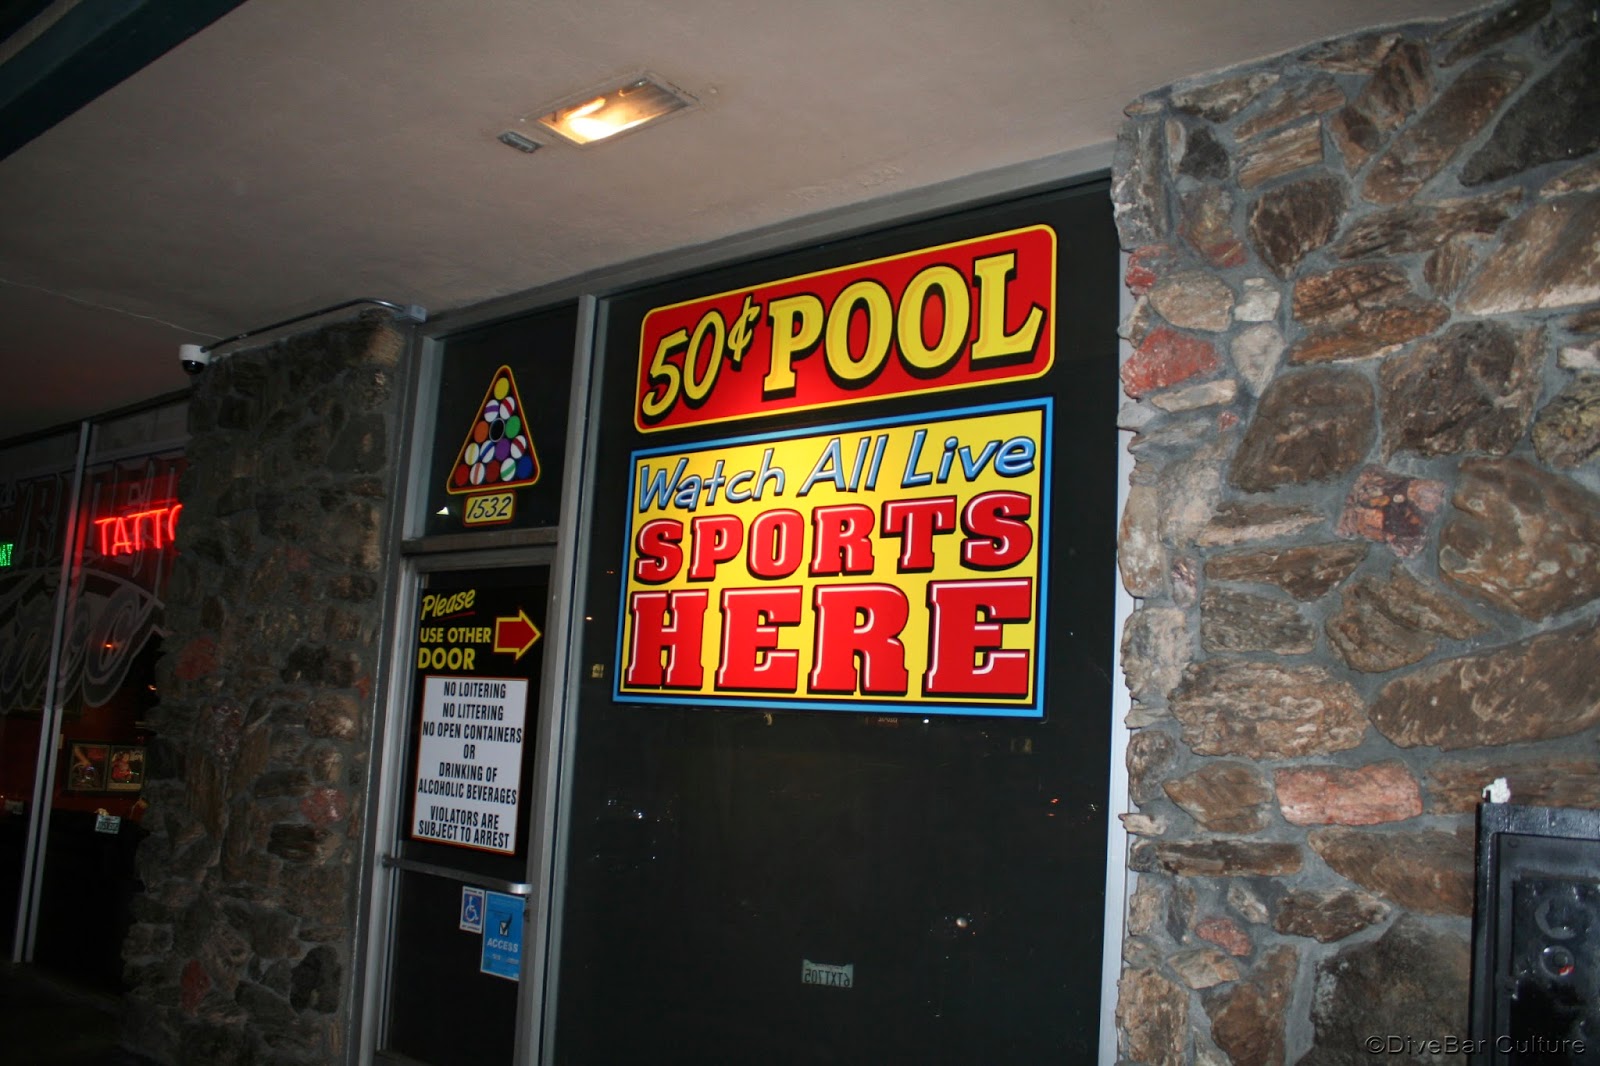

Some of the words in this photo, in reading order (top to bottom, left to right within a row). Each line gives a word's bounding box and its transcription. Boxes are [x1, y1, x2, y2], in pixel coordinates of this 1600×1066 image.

[640, 295, 761, 417] 50¢
[762, 251, 1046, 400] POOL
[637, 448, 786, 513] Watch
[798, 430, 890, 497] All
[900, 429, 1036, 491] Live
[466, 496, 512, 520] 1532
[635, 490, 1033, 585] SPORTS
[420, 589, 476, 620] Please
[420, 627, 443, 643] USE
[447, 627, 492, 644] OTHER
[625, 578, 1032, 699] HERE
[417, 647, 475, 670] DOOR
[443, 681, 456, 696] NO
[458, 682, 506, 699] LOITERING
[442, 703, 455, 718] NO
[457, 703, 504, 721] LITTERING
[422, 721, 435, 736] NO
[437, 722, 461, 738] OPEN
[463, 724, 522, 743] CONTAINERS
[463, 744, 475, 760] OR
[439, 762, 483, 781] DRINKING
[486, 767, 497, 782] OF
[418, 778, 464, 798] ALCOHOLIC
[466, 784, 517, 805] BEVERAGES
[430, 805, 478, 827] VIOLATORS
[481, 813, 499, 830] ARE
[418, 820, 458, 840] SUBJECT
[460, 826, 471, 842] TO
[473, 829, 510, 848] ARREST
[487, 937, 519, 953] ACCESS
